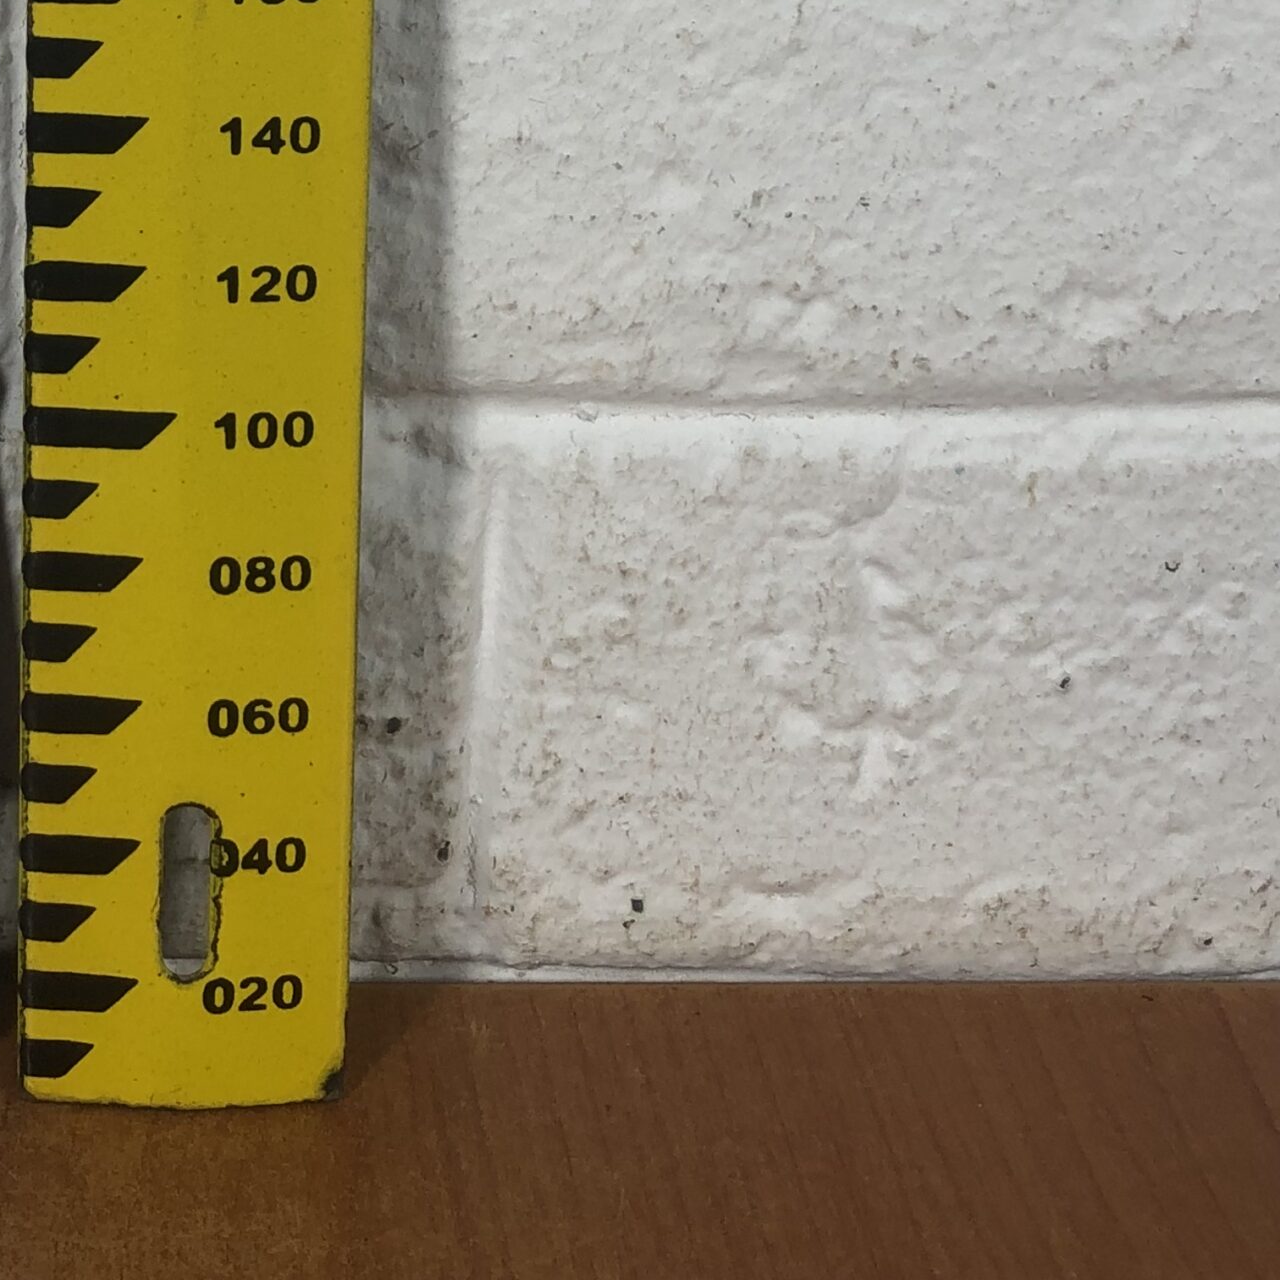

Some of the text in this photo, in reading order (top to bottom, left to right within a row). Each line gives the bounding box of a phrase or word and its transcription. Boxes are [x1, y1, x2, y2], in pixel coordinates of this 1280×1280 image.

[220, 116, 320, 155] 140
[217, 265, 316, 303] 120
[215, 411, 313, 449] 100
[210, 556, 311, 595] 080
[208, 698, 308, 737] 060
[203, 975, 302, 1014] 020
